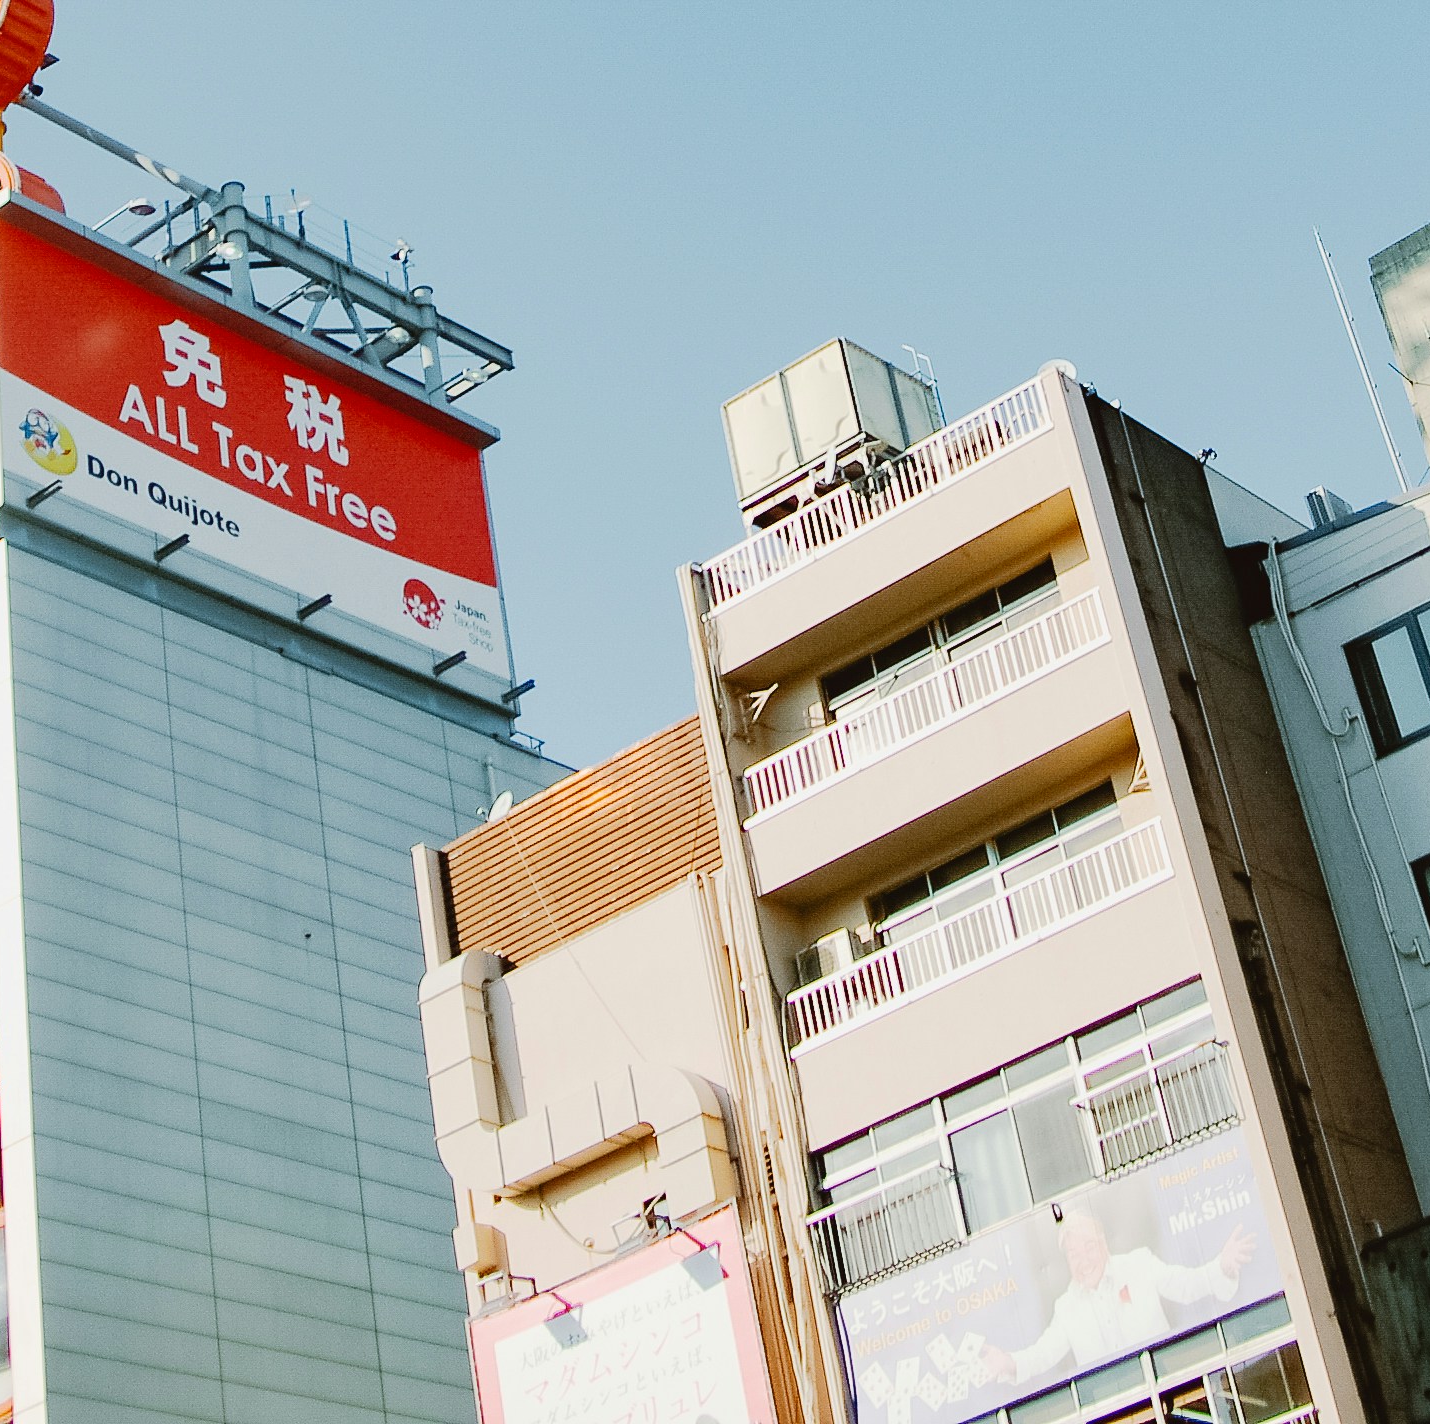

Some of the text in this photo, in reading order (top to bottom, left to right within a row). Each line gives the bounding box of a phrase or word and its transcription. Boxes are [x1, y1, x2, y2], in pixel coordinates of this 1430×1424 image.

[157, 318, 350, 467] 免税
[86, 452, 241, 539] Don Quijote
[117, 383, 397, 543] ALL Tax Free
[1158, 1144, 1240, 1192] Magic Artist
[1168, 1188, 1251, 1236] Mr.Shin
[523, 1311, 703, 1405] マダムシンコ
[855, 1276, 1019, 1359] Welcome to OSAKA
